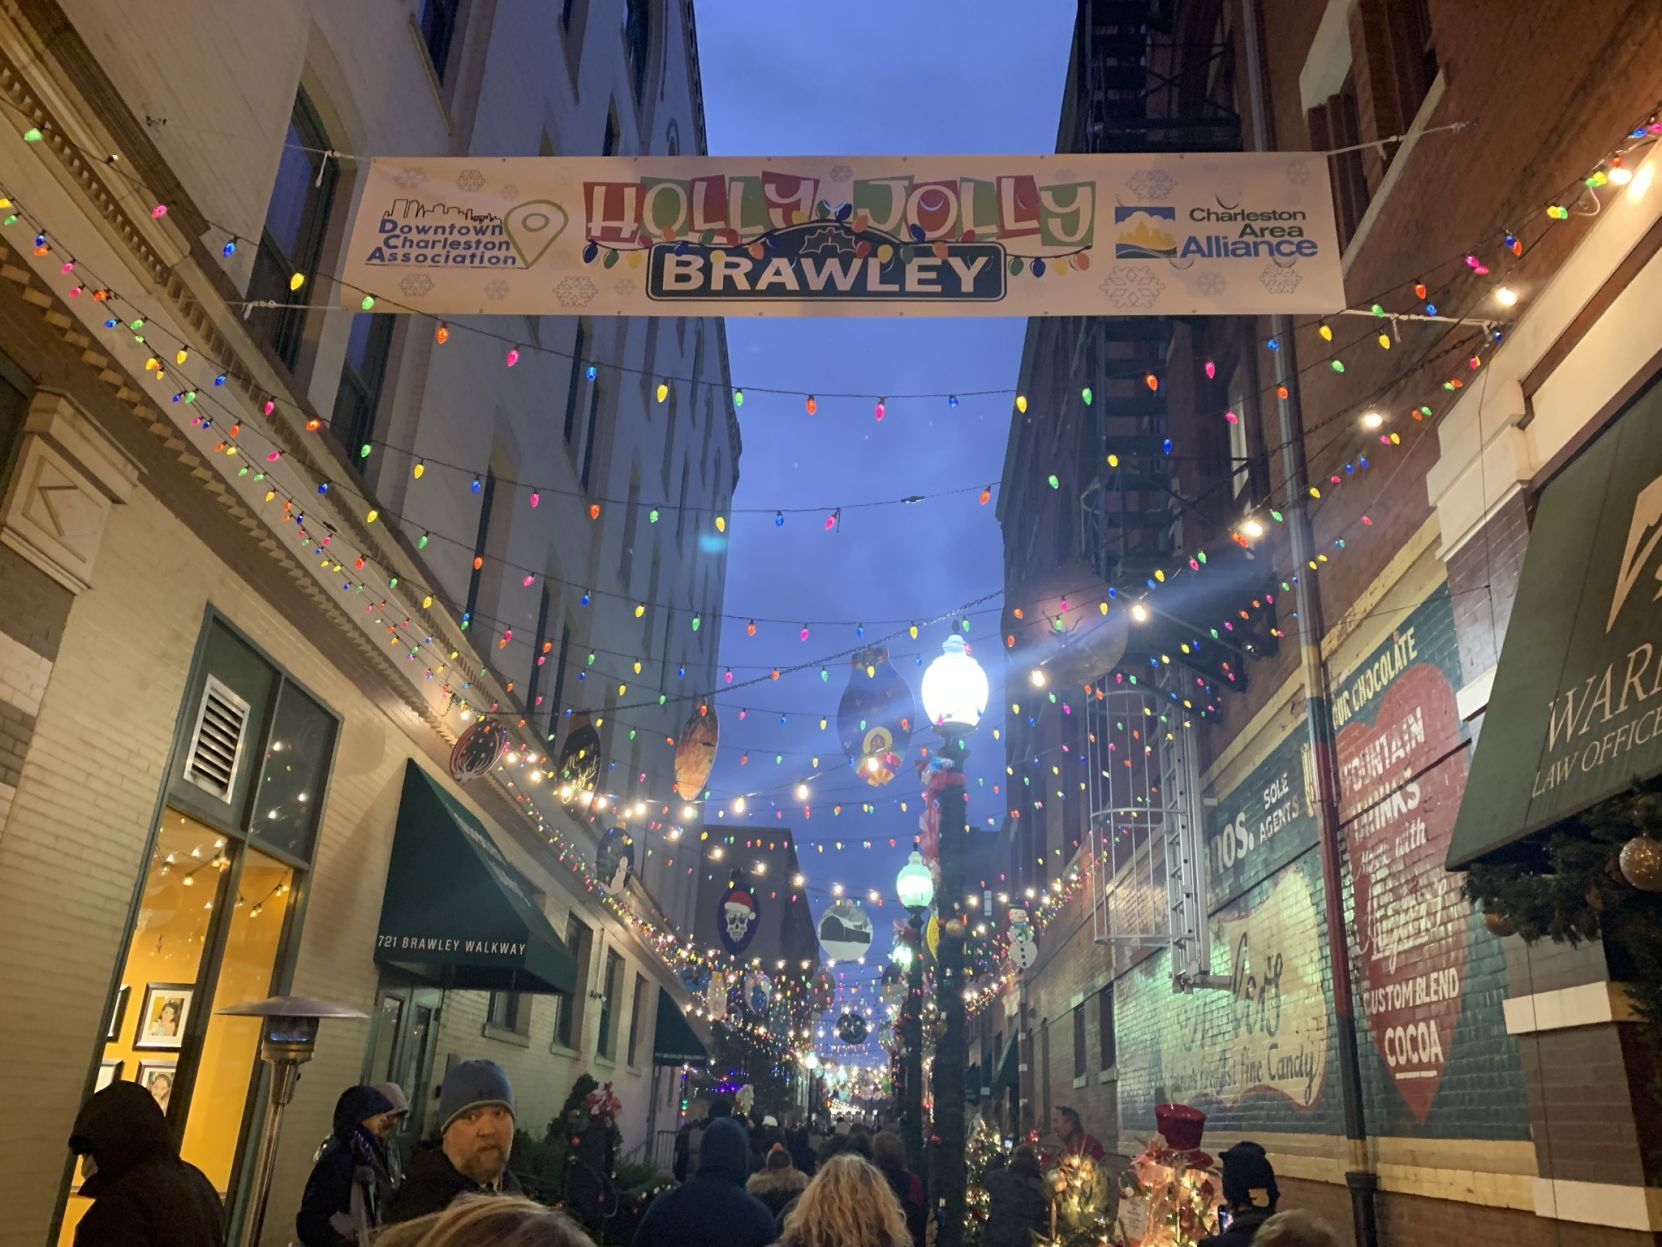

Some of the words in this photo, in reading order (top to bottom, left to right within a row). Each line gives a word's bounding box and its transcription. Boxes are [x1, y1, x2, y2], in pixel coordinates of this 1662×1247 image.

[378, 218, 504, 237] Downtown
[587, 179, 815, 239] HOLLY
[856, 178, 1093, 242] JOLLY
[1189, 208, 1306, 222] Charleston
[383, 234, 511, 252] Charleston
[1179, 235, 1319, 259] Alliance
[1238, 223, 1305, 239] Area
[366, 246, 517, 266] Association
[662, 253, 990, 293] BRAWLEY
[1352, 626, 1418, 712] CHOCOLATE
[1263, 772, 1290, 811] SOLE
[1532, 751, 1578, 798] LAW
[1259, 794, 1300, 844] AGENTS
[378, 935, 398, 948] 721
[402, 936, 460, 951] BRAWLEY
[465, 940, 526, 955] WALKWAY
[1363, 979, 1414, 1015] CUSTOM
[1414, 967, 1460, 1007] BLEND
[1384, 1019, 1444, 1068] COCOA
[1266, 1043, 1318, 1105] Candy
